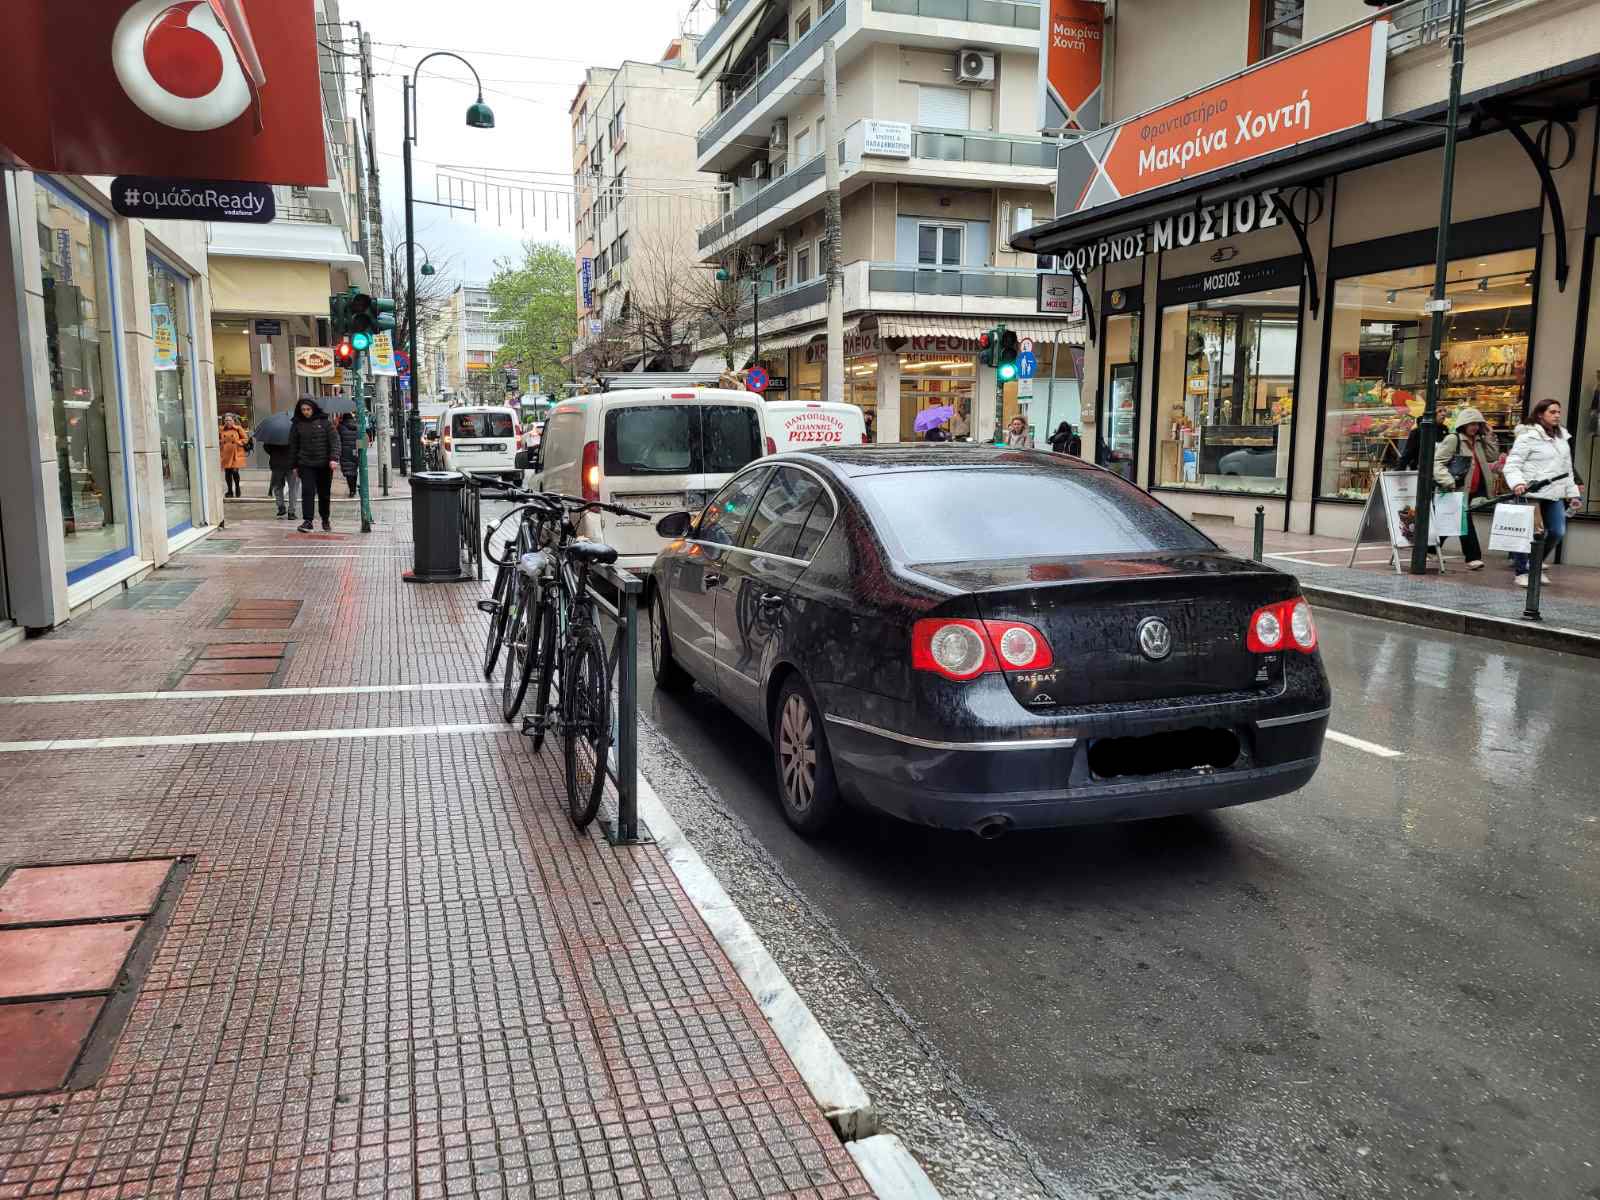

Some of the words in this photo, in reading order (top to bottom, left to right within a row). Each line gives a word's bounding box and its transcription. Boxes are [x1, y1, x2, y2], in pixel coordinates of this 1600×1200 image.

[1138, 128, 1228, 176] Μακρίνα
[1234, 89, 1311, 145] Χοντή
[1141, 98, 1228, 141] Φροντιστήριο
[124, 187, 265, 214] #ομάδαReady
[1063, 233, 1145, 271] ΦΟΥΡΝΟΣ
[1153, 187, 1280, 253] ΜΟΣΙΟΣ
[1203, 271, 1241, 292] ΜΟΣΙΟΣ
[788, 431, 842, 442] ΡΩΣΣΟΣ
